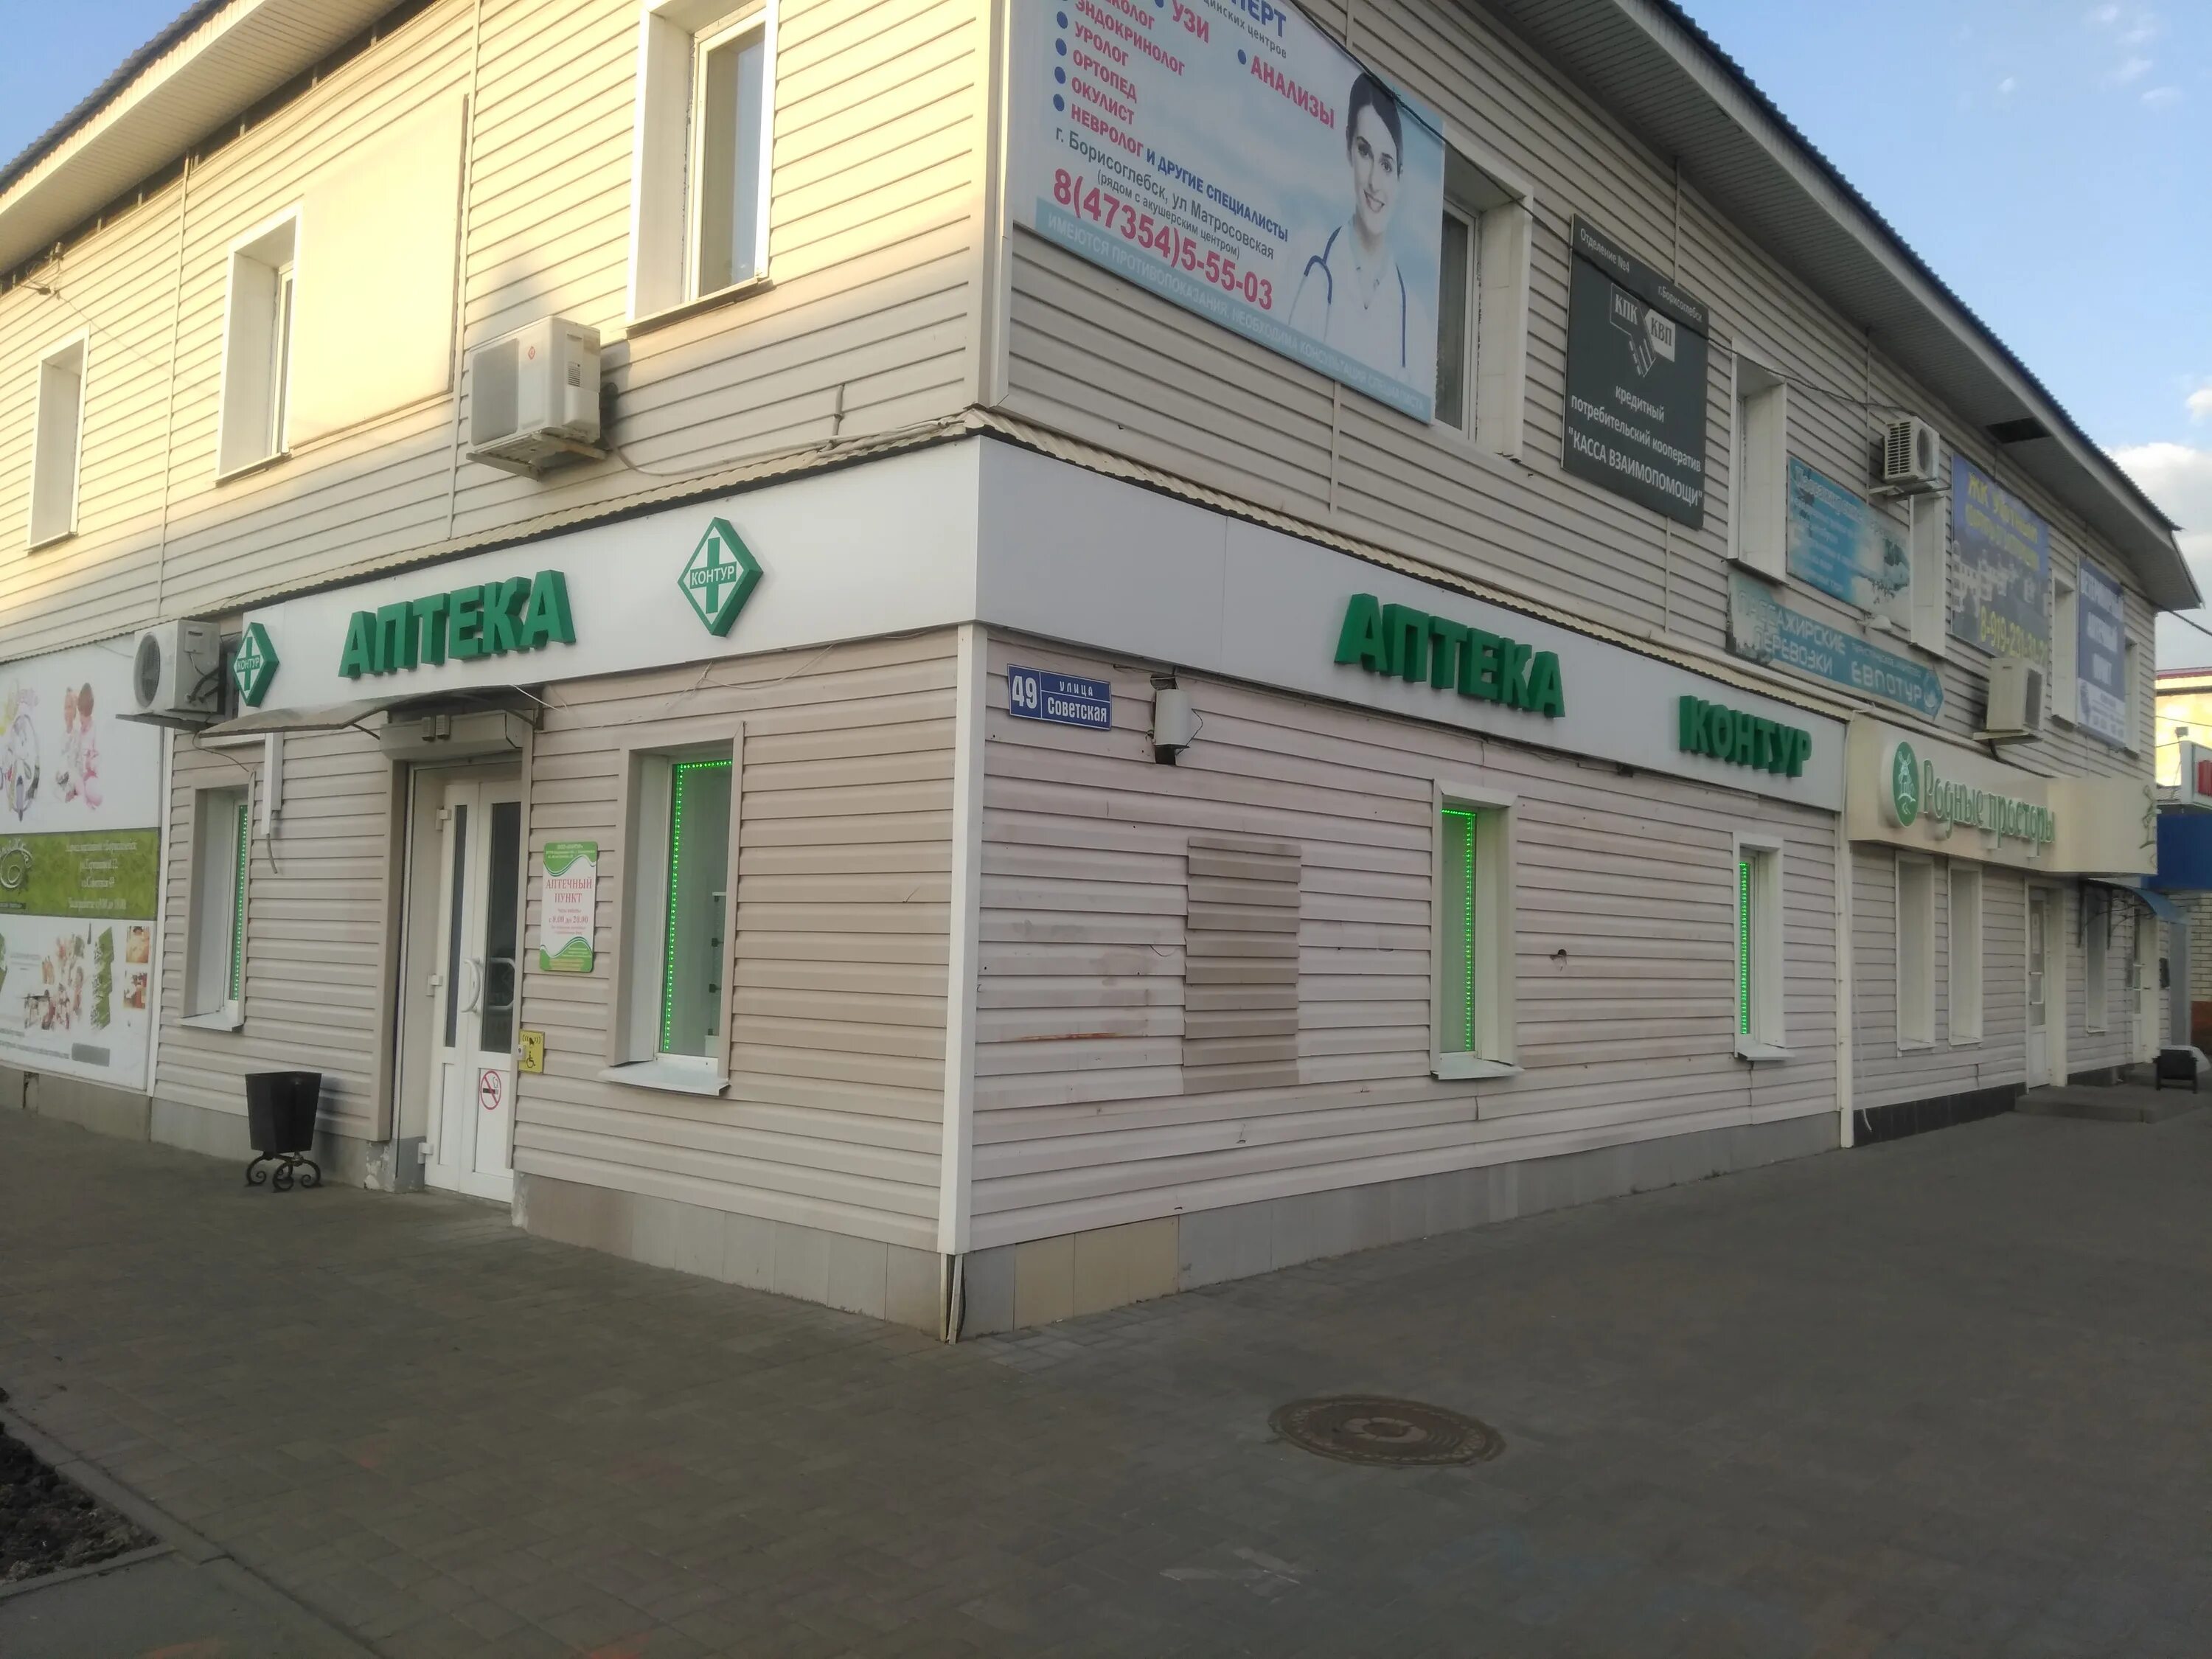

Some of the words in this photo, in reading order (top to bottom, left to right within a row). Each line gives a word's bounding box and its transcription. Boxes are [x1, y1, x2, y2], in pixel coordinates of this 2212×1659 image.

[1075, 0, 1185, 77] ЭНДОКРИНОЛОГ
[1075, 21, 1129, 67] УРОЛОГ
[1172, 0, 1209, 44] УЗИ
[1248, 24, 1287, 59] центров
[1071, 76, 1135, 125] ОКУЛИСТ
[1073, 49, 1137, 104] ОРТОПЕД
[1251, 55, 1335, 130] АНАЛИЗЫ
[1055, 127, 1064, 143] г.
[1069, 130, 1169, 204] Борисоглебск,
[1172, 192, 1187, 213] ул
[1191, 199, 1274, 260] Матросовская
[1071, 103, 1144, 158] НЕВРОЛОГ
[1147, 147, 1155, 166] И
[1158, 156, 1203, 194] ДРУГИЕ
[1206, 184, 1289, 243] СПЕЦИАЛИСТЫ
[1048, 212, 1110, 260] ИМЕЮТСЯ
[1054, 168, 1273, 310] 8(47354)5-55-03
[1097, 169, 1133, 199] (рядом
[1135, 192, 1141, 204] с
[1143, 196, 1198, 234] акушерским
[1200, 229, 1240, 260] центром)
[1580, 228, 1617, 265] Отделение
[1615, 293, 1638, 325] КПК
[1651, 316, 1672, 347] КВП
[1615, 386, 1665, 422] кредитный
[1571, 394, 1651, 448] потребительский
[1652, 438, 1701, 473] кооператив
[691, 566, 735, 585] КОНТУР
[338, 569, 576, 680] АПТЕКА
[236, 656, 261, 671] КОНТУР
[1334, 593, 1565, 718] АПТЕКА
[1012, 675, 1038, 709] 49
[1048, 697, 1107, 723] Советская
[1679, 695, 1812, 779] КОНТУР
[1924, 759, 1984, 840] Родные
[1985, 793, 2056, 858] просторы
[546, 876, 592, 889] АПТЕЧНЫЙ
[554, 893, 582, 903] ПУНКТ
